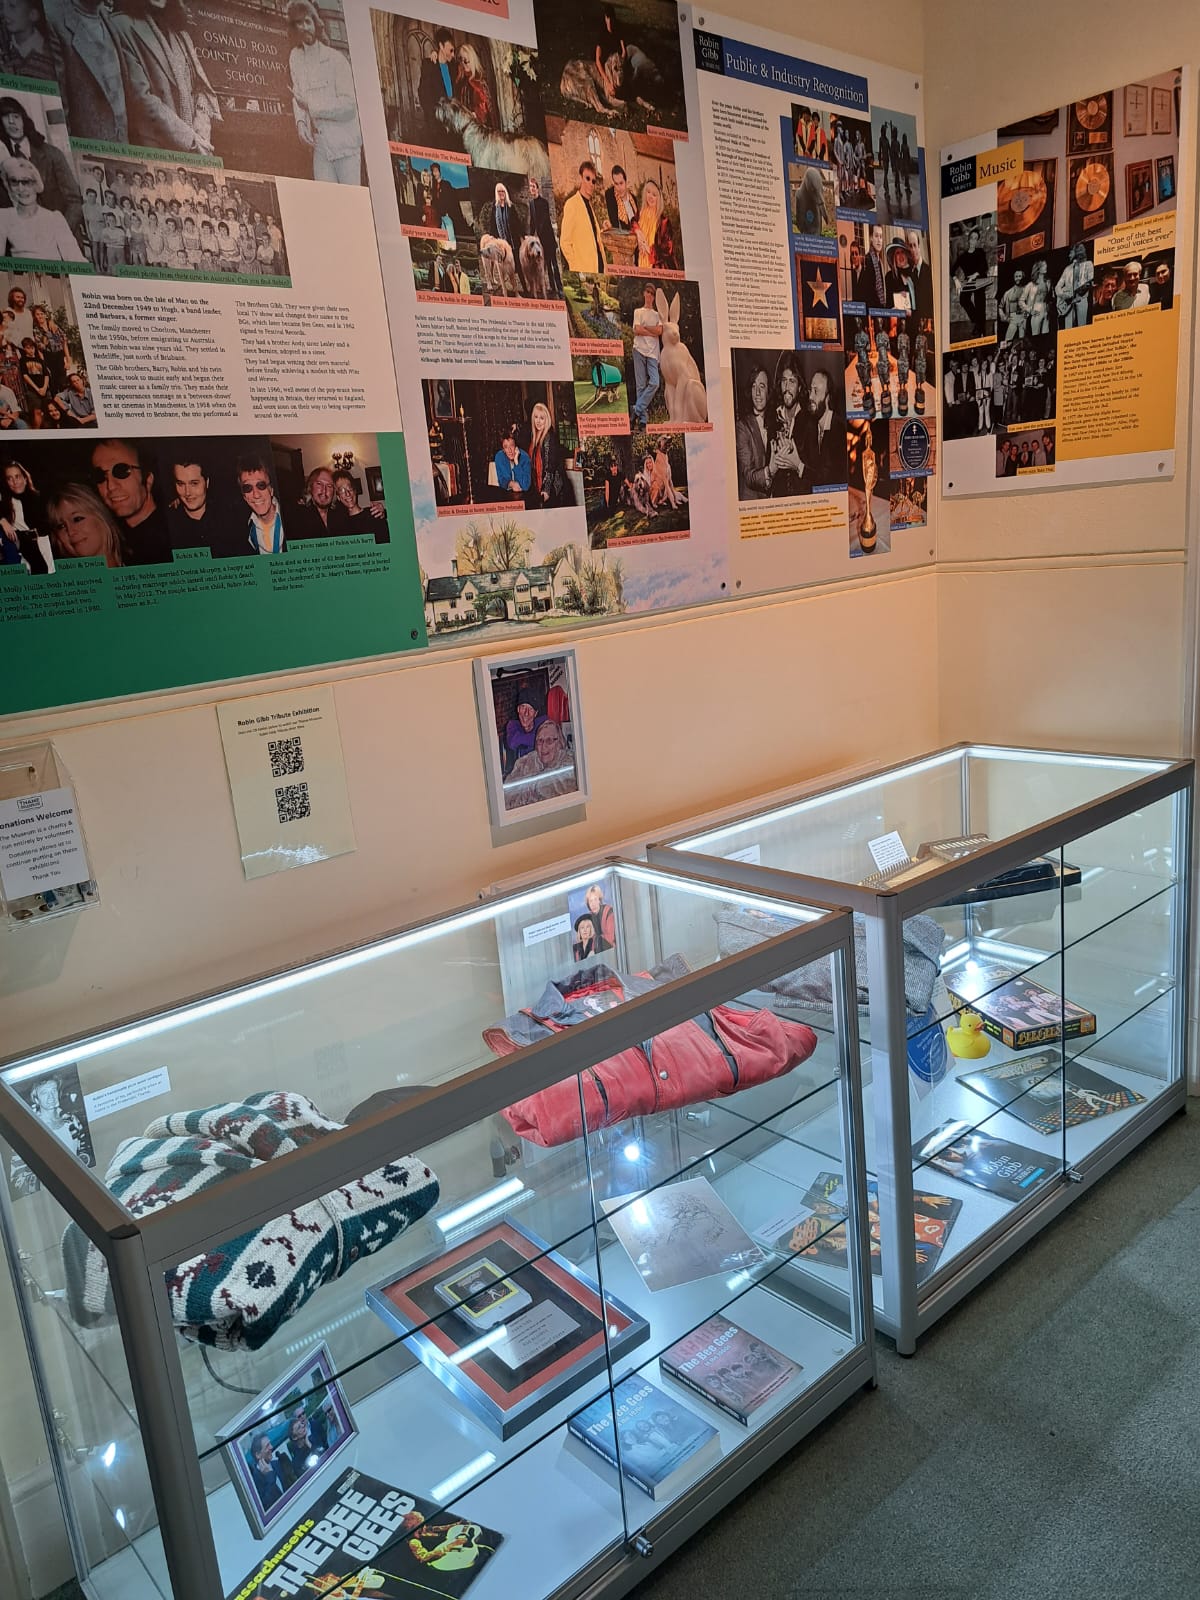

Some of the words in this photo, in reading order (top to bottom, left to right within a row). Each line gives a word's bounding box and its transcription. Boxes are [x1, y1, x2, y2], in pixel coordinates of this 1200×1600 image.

[204, 31, 246, 48] OSWALD
[251, 41, 277, 55] ROAD
[699, 35, 719, 50] Robin
[195, 47, 239, 64] COUNTY
[247, 57, 287, 72] PRIMARY
[702, 48, 718, 60] Gibb
[225, 69, 268, 85] SCHOOL
[726, 53, 758, 75] Public
[761, 63, 768, 78] &
[771, 66, 810, 92] Industry
[813, 77, 864, 103] Recognition
[950, 162, 972, 176] Robin
[979, 157, 1016, 179] Music
[952, 172, 970, 184] Gibb
[1126, 233, 1134, 241] of
[1097, 246, 1116, 255] white
[1117, 242, 1130, 251] soul
[1132, 238, 1153, 247] voices
[82, 292, 101, 300] Robin
[102, 302, 134, 310] December
[161, 305, 179, 315] Hugh,
[186, 306, 201, 314] band
[292, 707, 320, 716] Exhibition
[0, 817, 34, 829] onations
[36, 808, 73, 820] Welcome
[11, 829, 36, 839] Museum
[13, 837, 35, 847] entirely
[36, 835, 43, 843] by
[45, 829, 74, 839] volunteers
[6, 858, 31, 868] continue
[33, 852, 53, 863] putting
[9, 848, 38, 859] Donations
[1017, 1028, 1038, 1046] BEE
[981, 1155, 1011, 1175] Robin
[997, 1161, 1022, 1178] Gibb
[679, 1358, 700, 1372] The
[696, 1345, 716, 1360] Bee
[713, 1326, 738, 1347] Gees
[587, 1420, 609, 1435] The
[626, 1385, 653, 1406] Gees
[342, 1490, 415, 1561] GEES
[234, 1519, 315, 1600] assachusetts
